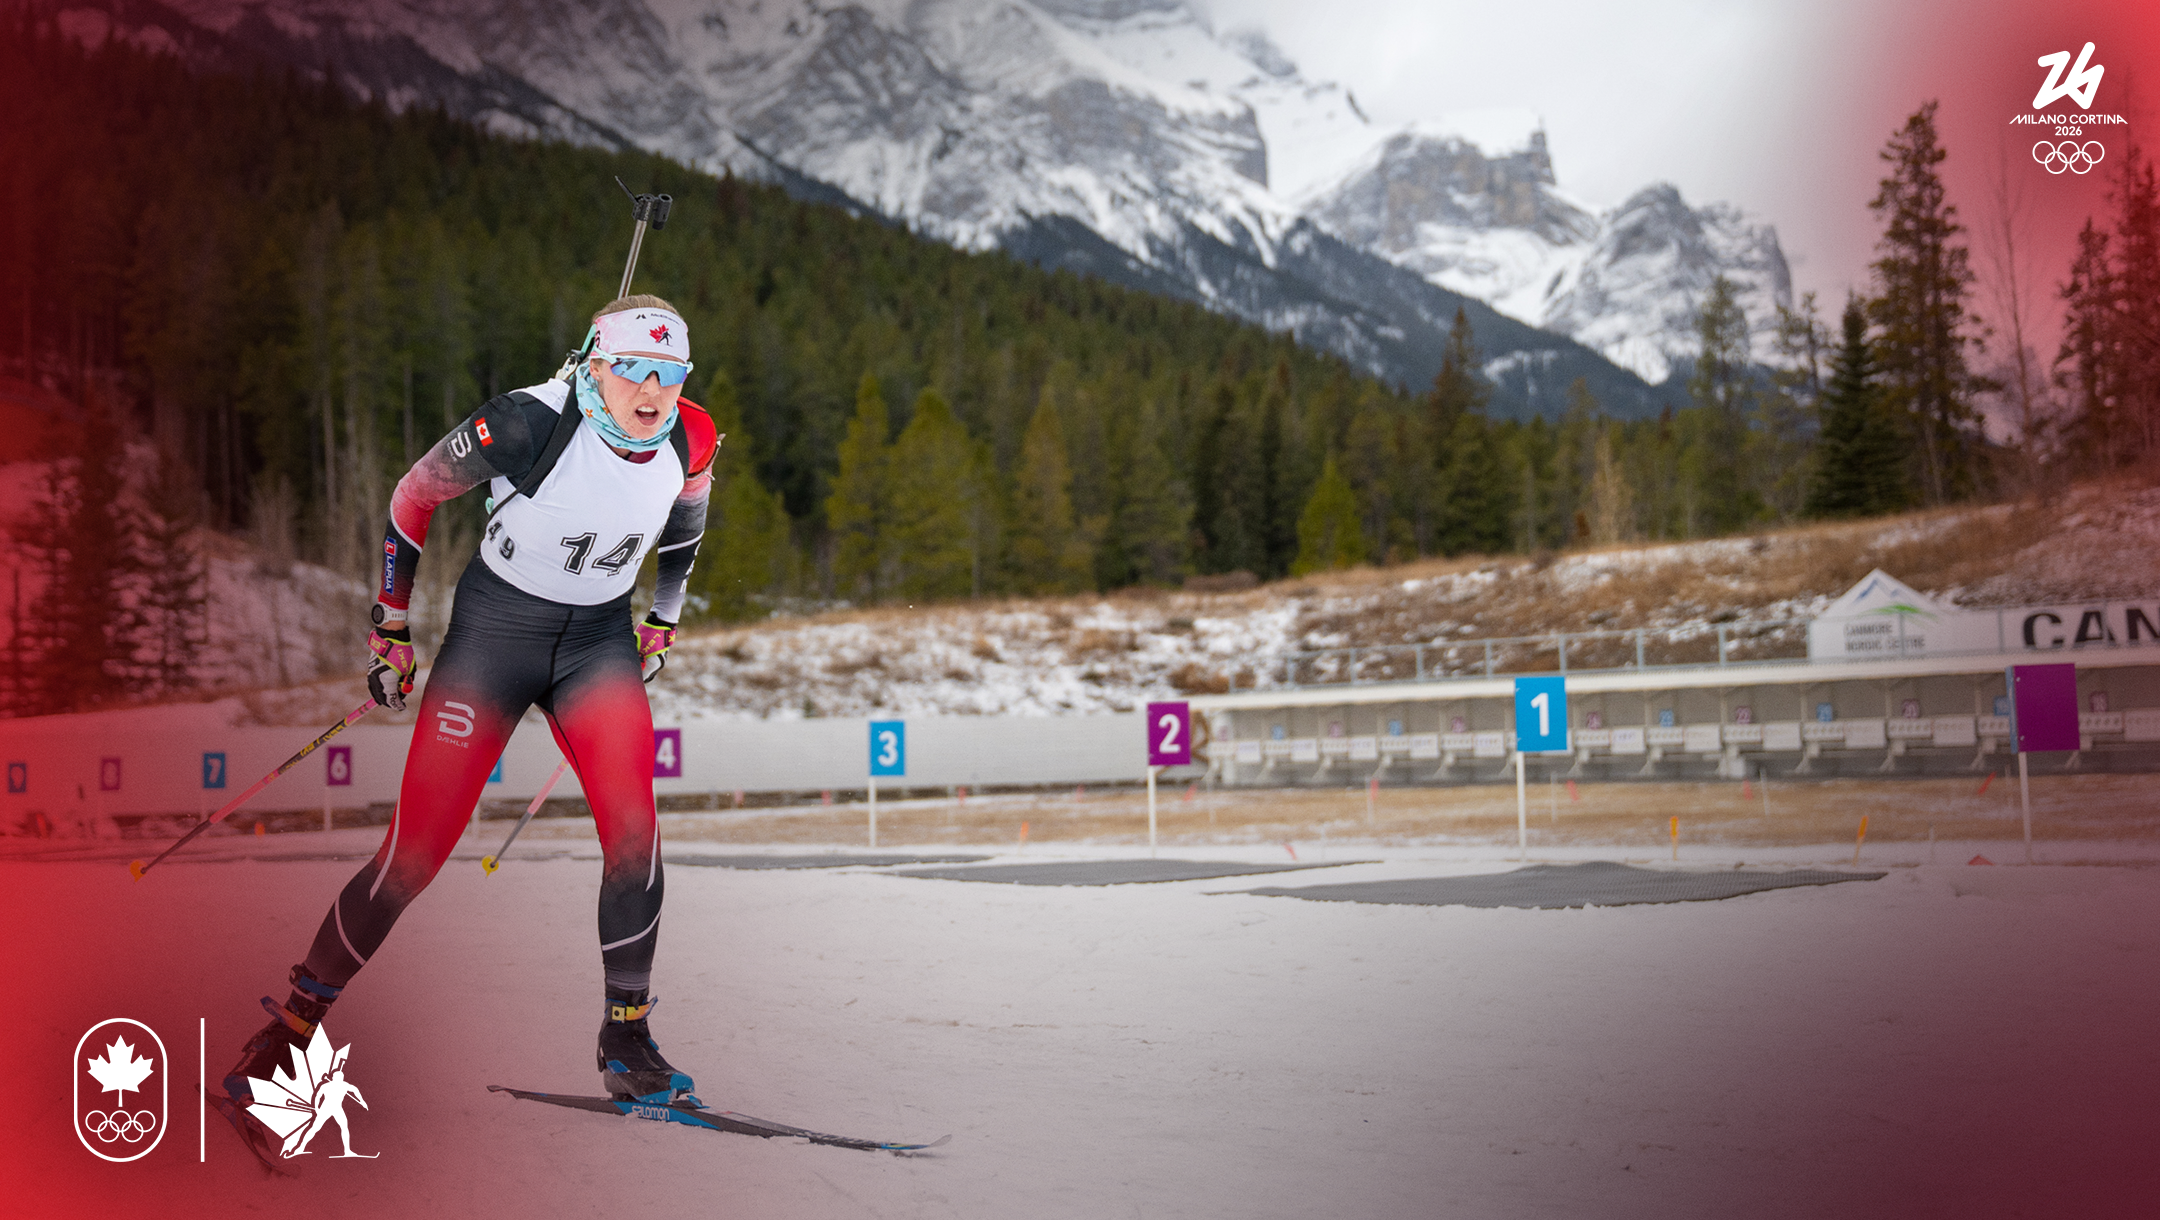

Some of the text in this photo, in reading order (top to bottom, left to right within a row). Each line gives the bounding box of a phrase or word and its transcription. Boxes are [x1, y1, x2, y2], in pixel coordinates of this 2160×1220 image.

[560, 532, 644, 577] 14
[385, 555, 393, 590] LAPUA
[1530, 693, 1549, 737] 1
[878, 731, 898, 767] 3
[1158, 714, 1181, 753] 2
[208, 757, 222, 783] 7
[330, 752, 347, 780] 6
[656, 737, 676, 770] 4
